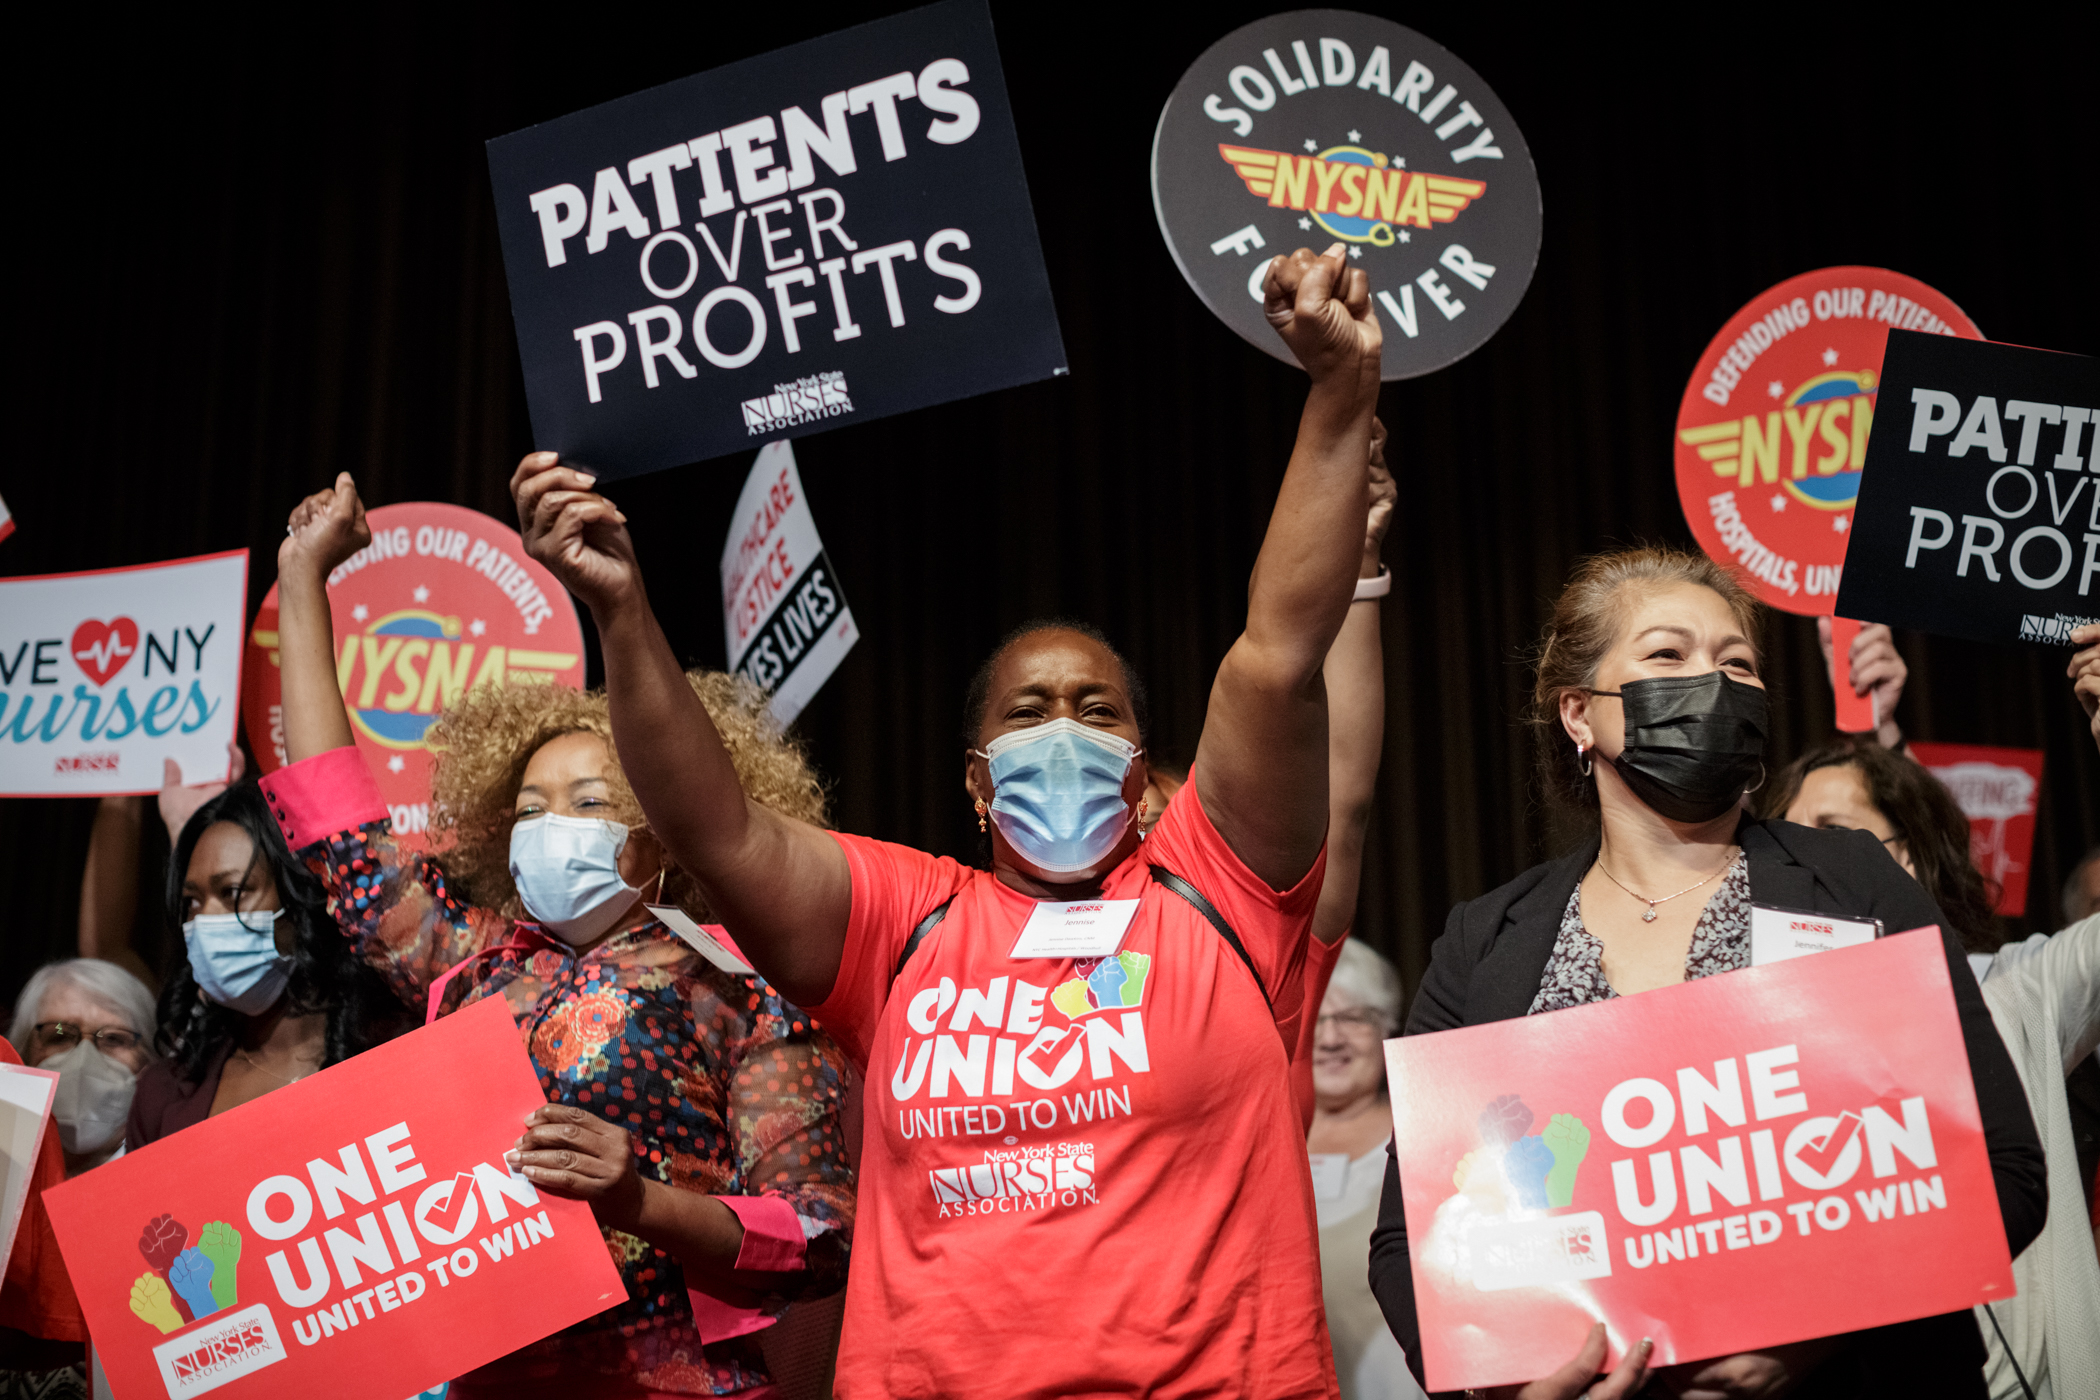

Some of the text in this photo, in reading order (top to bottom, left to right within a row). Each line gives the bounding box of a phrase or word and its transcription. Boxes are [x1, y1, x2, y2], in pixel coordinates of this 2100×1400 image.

[1203, 37, 1504, 163] SOLIDARITY
[529, 57, 981, 268] PATIENTS
[1271, 154, 1430, 227] NYSNA
[639, 187, 858, 299] OVER
[573, 228, 982, 403] PROFITS
[1703, 297, 1810, 406] DEFENDING
[1813, 287, 1866, 320] OUR
[741, 379, 848, 427] NURSES
[415, 525, 469, 562] OUR
[142, 622, 215, 679] NY
[773, 568, 836, 662] LIVES
[907, 975, 1048, 1035] ONE
[891, 1011, 1150, 1101] UNION
[1601, 1044, 1808, 1148] ONE
[901, 1084, 1132, 1140] UNITED TO WIN
[983, 1141, 1094, 1164] New York State
[246, 1121, 427, 1240] ONE
[929, 1154, 1095, 1204] NURSES
[1611, 1096, 1938, 1226] UNION
[265, 1148, 541, 1308] UNION
[1624, 1209, 1783, 1269] UNITED
[1786, 1195, 1850, 1236] TO
[1854, 1175, 1947, 1222] WIN
[292, 1210, 555, 1346] UNITED TO WIN
[171, 1325, 265, 1380] NURSES
[199, 1317, 259, 1348] New York State
